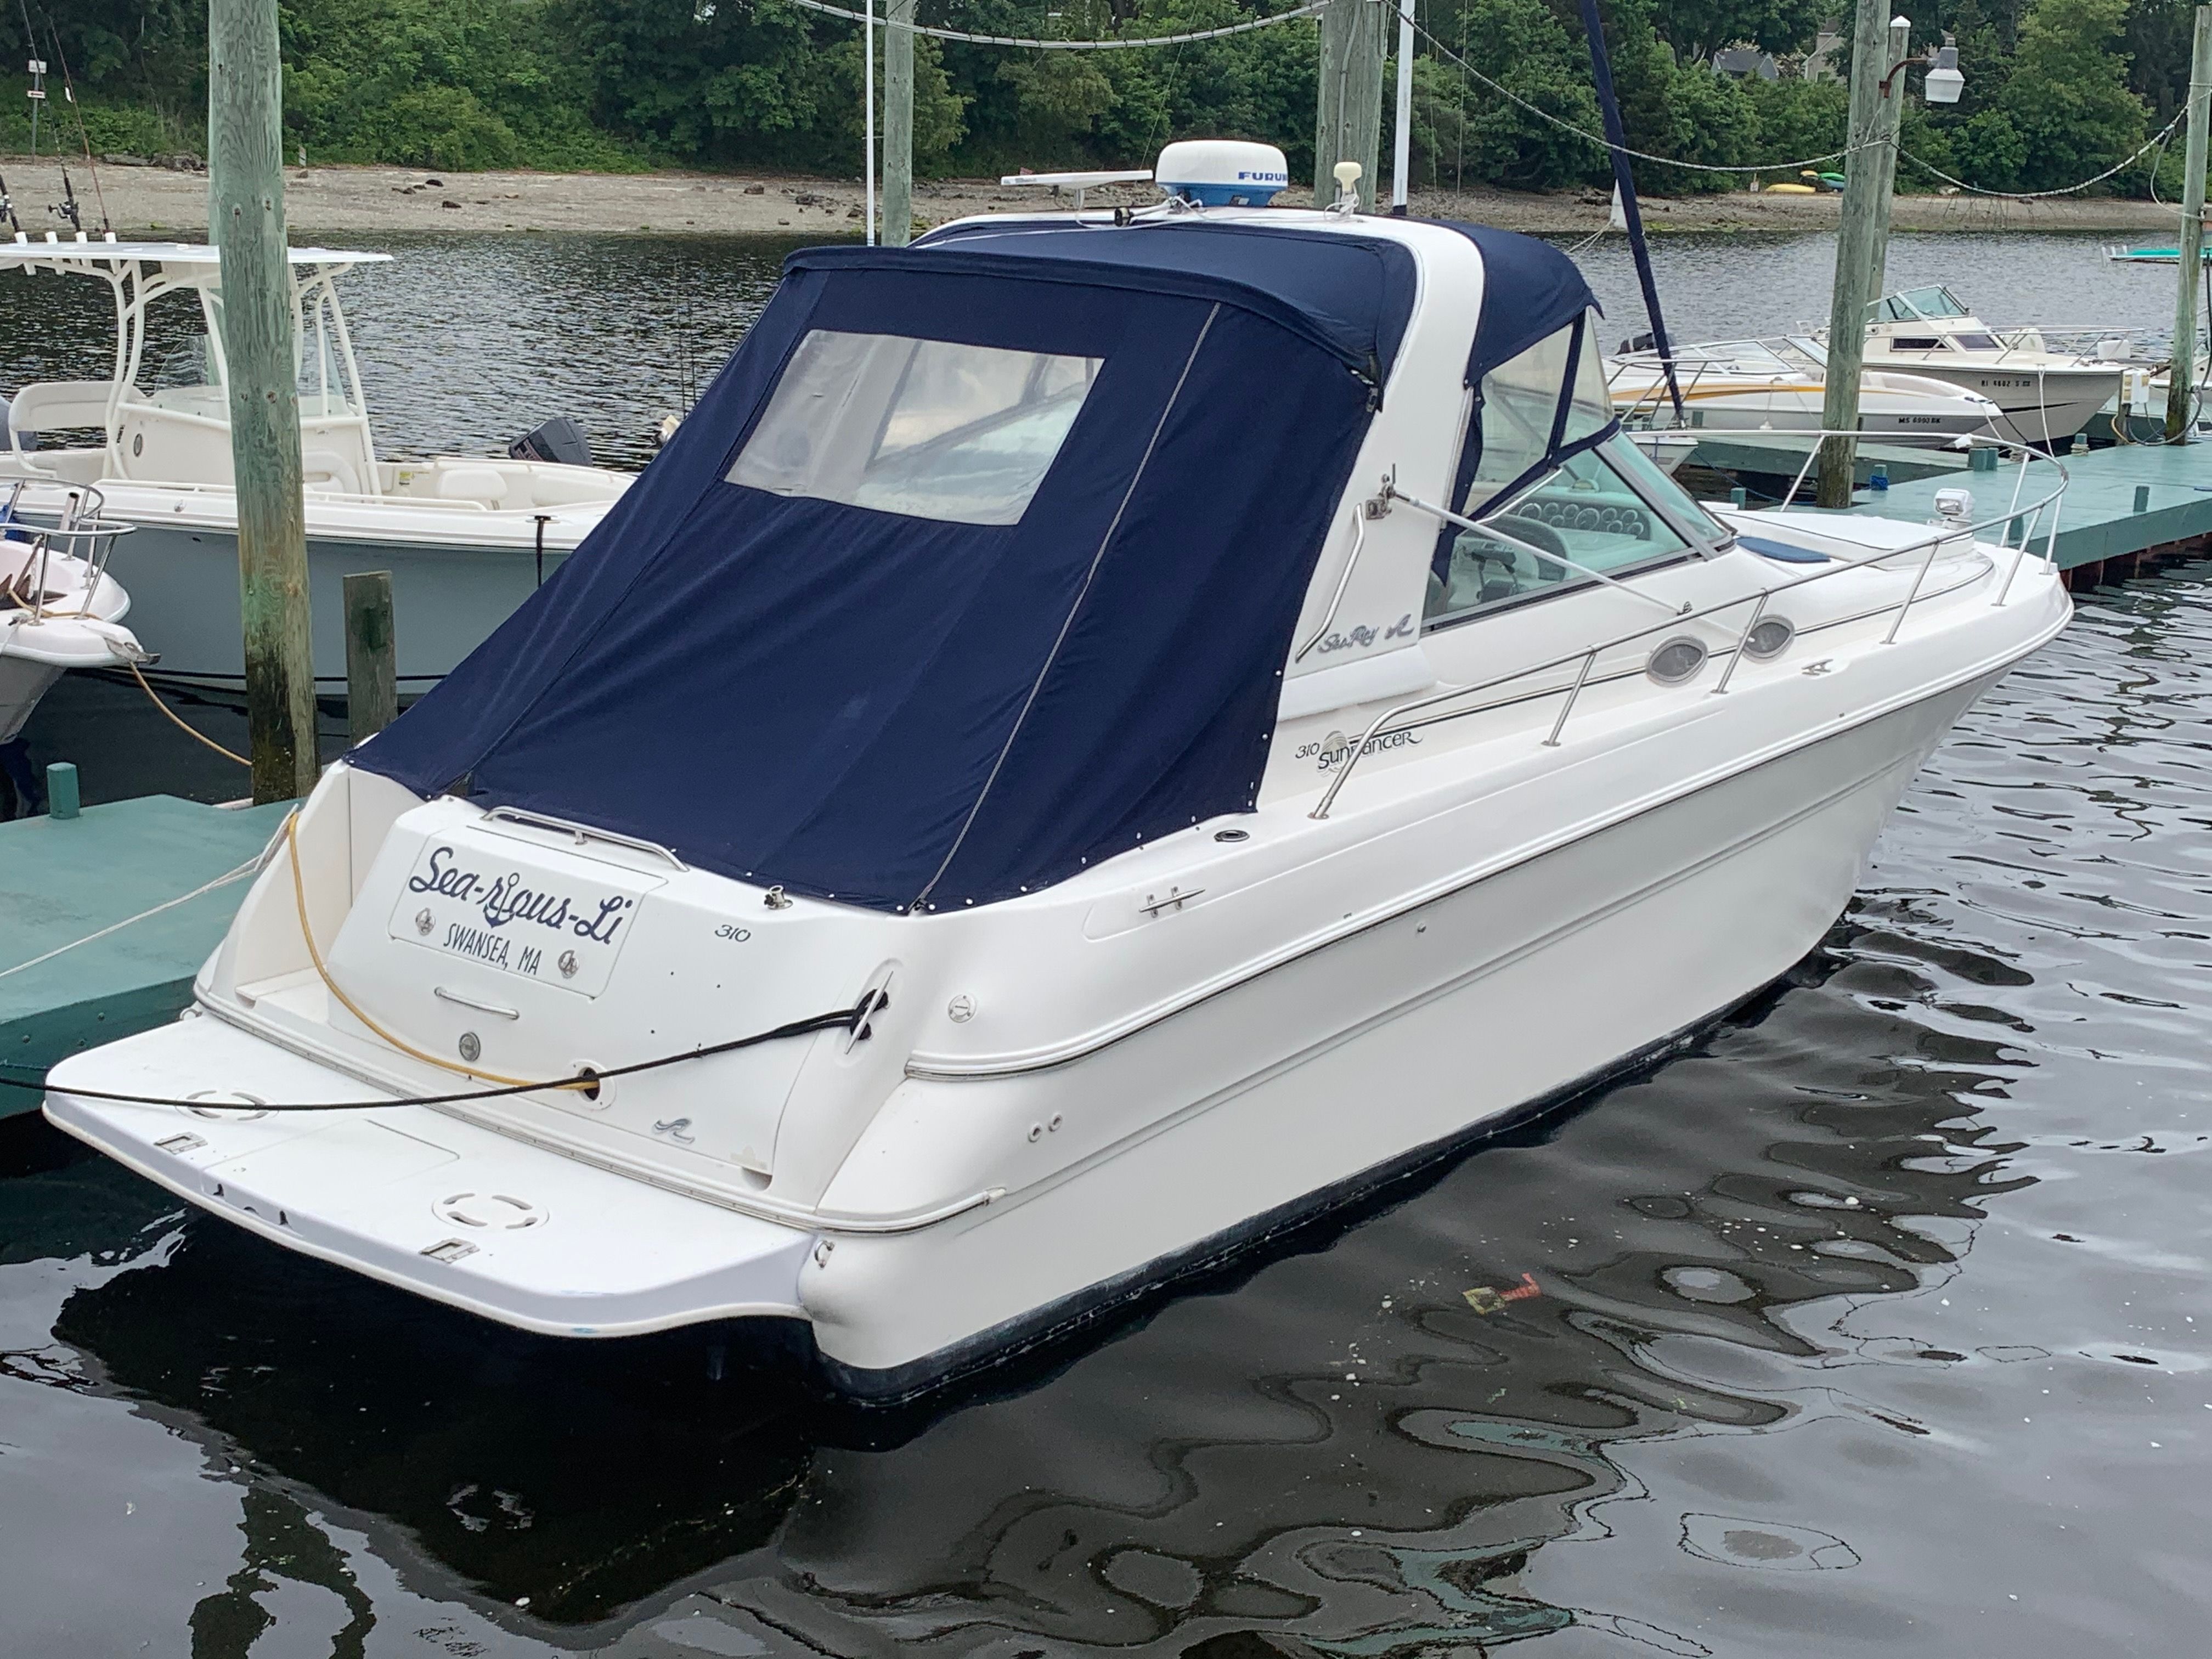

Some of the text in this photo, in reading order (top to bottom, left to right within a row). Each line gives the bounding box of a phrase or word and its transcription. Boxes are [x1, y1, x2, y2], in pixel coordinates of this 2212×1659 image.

[1295, 742, 1320, 759] 310
[714, 924, 751, 943] 310
[443, 923, 542, 975] SWANSEA, MA
